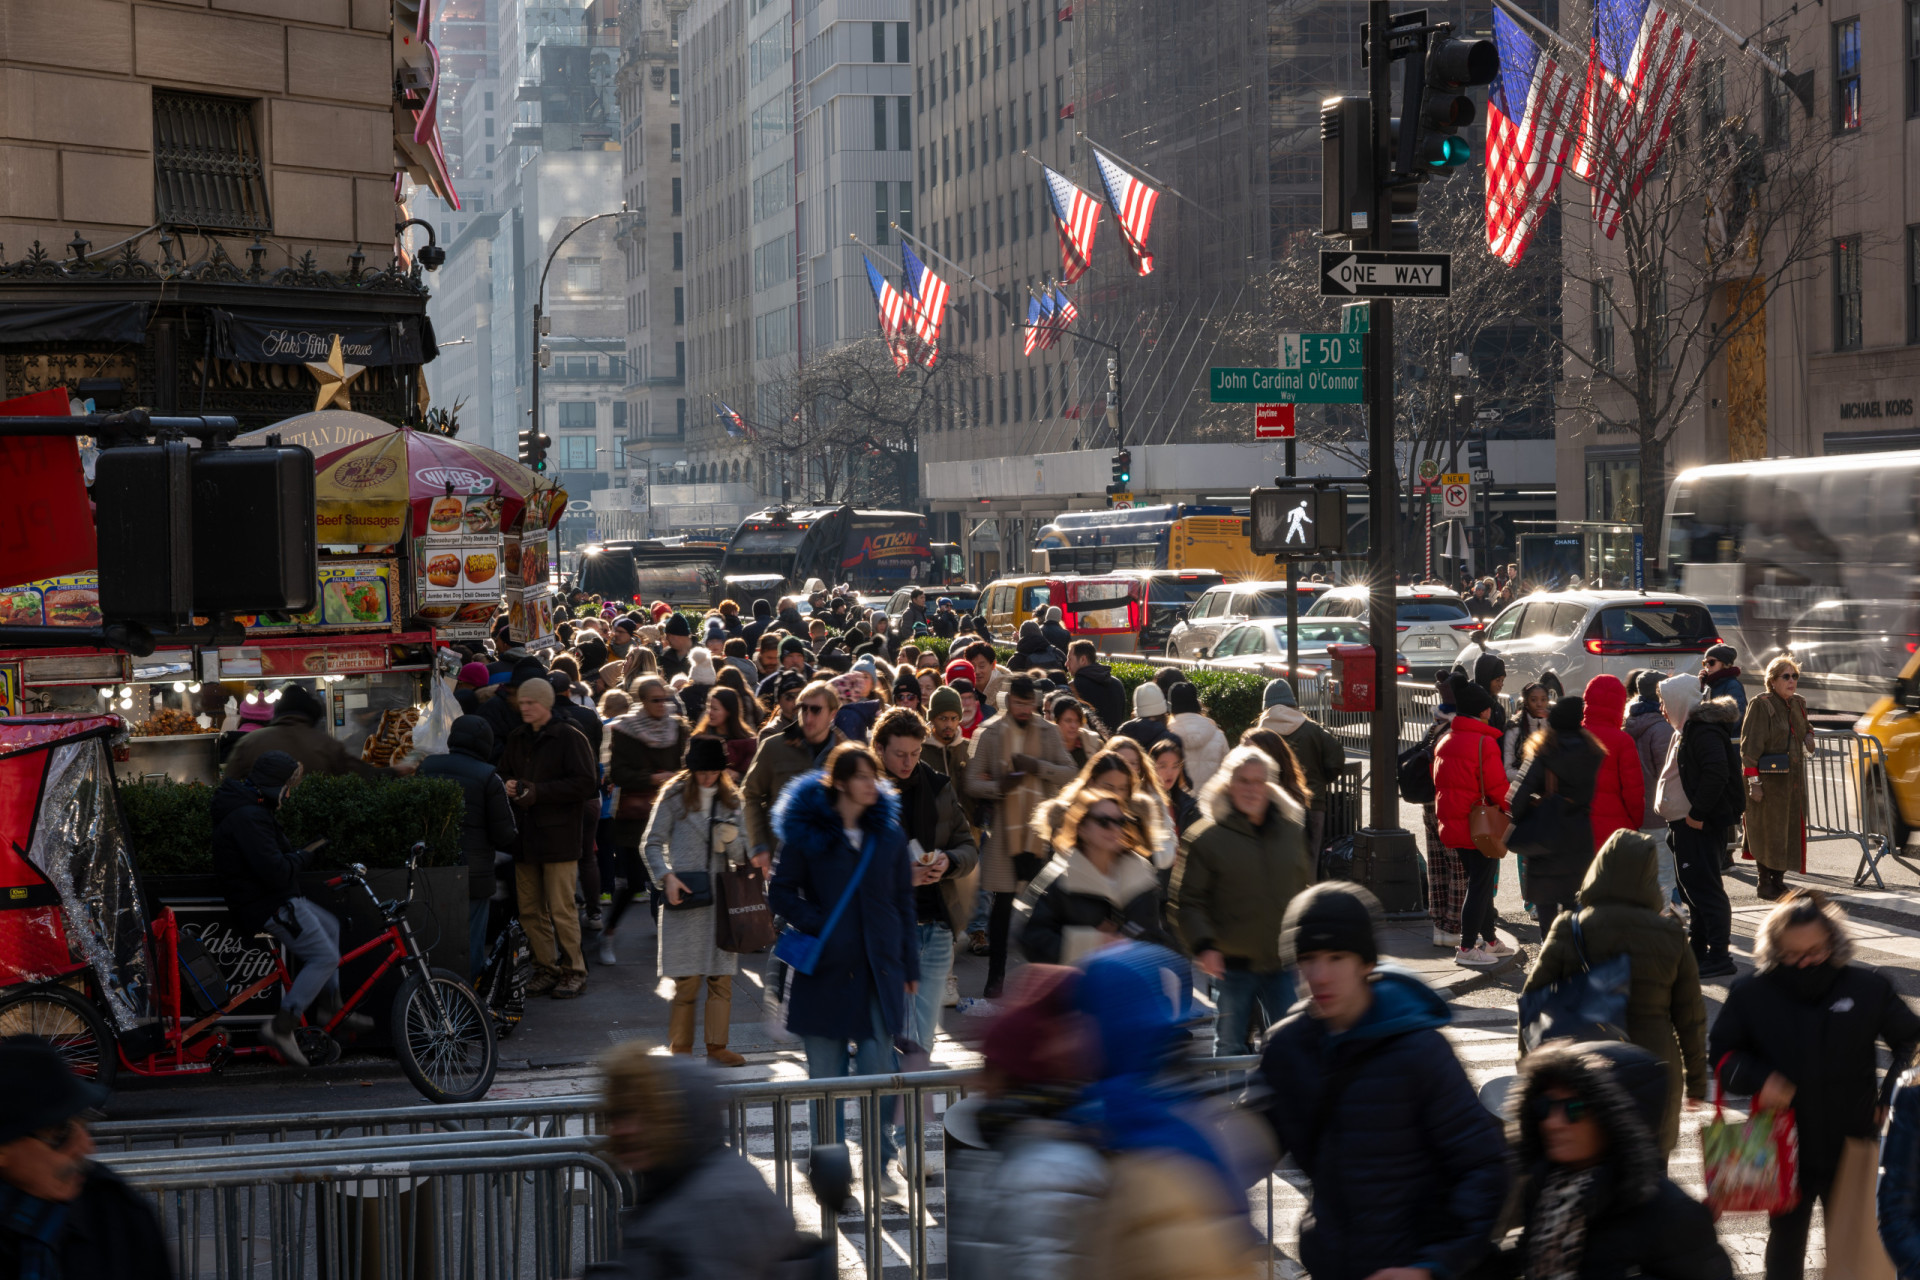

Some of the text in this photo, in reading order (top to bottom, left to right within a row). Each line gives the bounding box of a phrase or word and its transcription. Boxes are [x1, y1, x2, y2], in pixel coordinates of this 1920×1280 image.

[1341, 266, 1434, 284] ONE WAY
[262, 330, 300, 357] Saks
[296, 332, 328, 359] Fifth
[1302, 338, 1360, 364] E 50 St
[1217, 371, 1359, 390] John Cardinal O'Connor
[1281, 391, 1296, 402] Way
[1258, 409, 1278, 419] Anytime
[1840, 399, 1913, 419] MICHAEL KORS
[424, 471, 476, 486] NIKAS
[1447, 475, 1464, 483] NEW
[317, 513, 400, 529] Beef Sausages
[862, 532, 919, 553] ACTION
[453, 591, 461, 599] Dog
